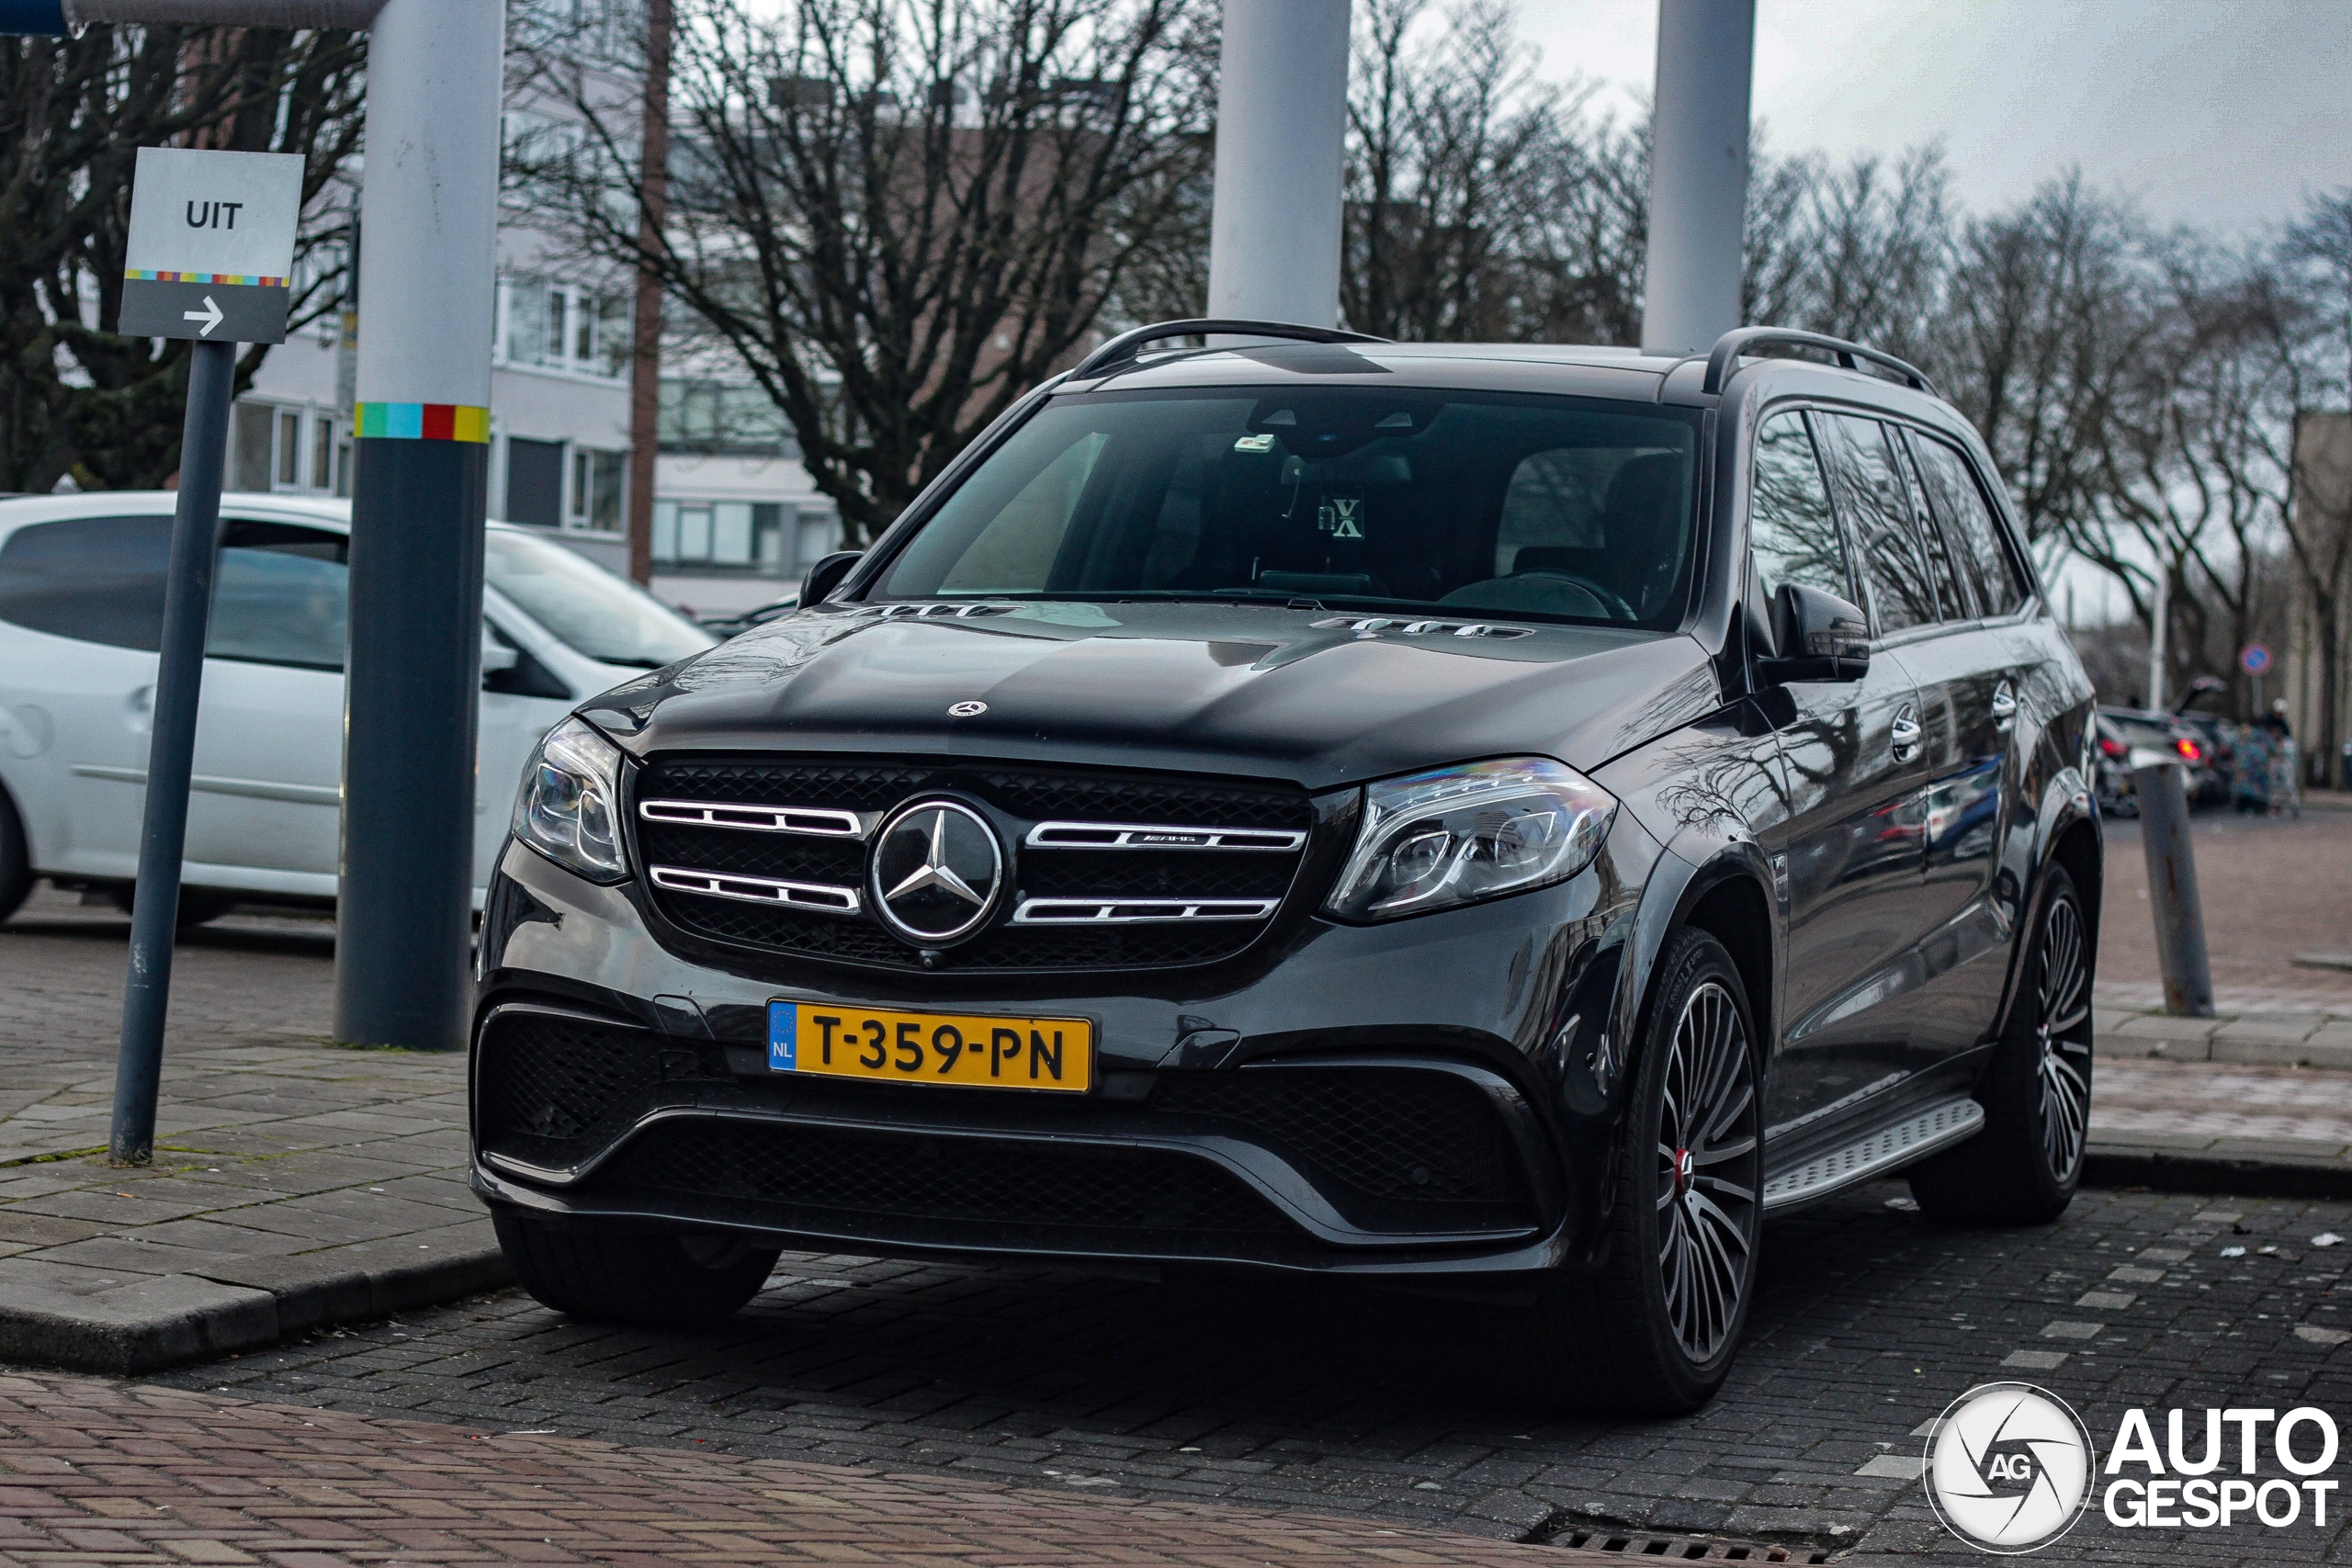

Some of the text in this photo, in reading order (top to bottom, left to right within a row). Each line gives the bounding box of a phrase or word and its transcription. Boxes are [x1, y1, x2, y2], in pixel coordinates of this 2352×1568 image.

[187, 200, 243, 230] UIT
[773, 1041, 792, 1058] NL
[813, 1015, 1063, 1080] T-359-PN
